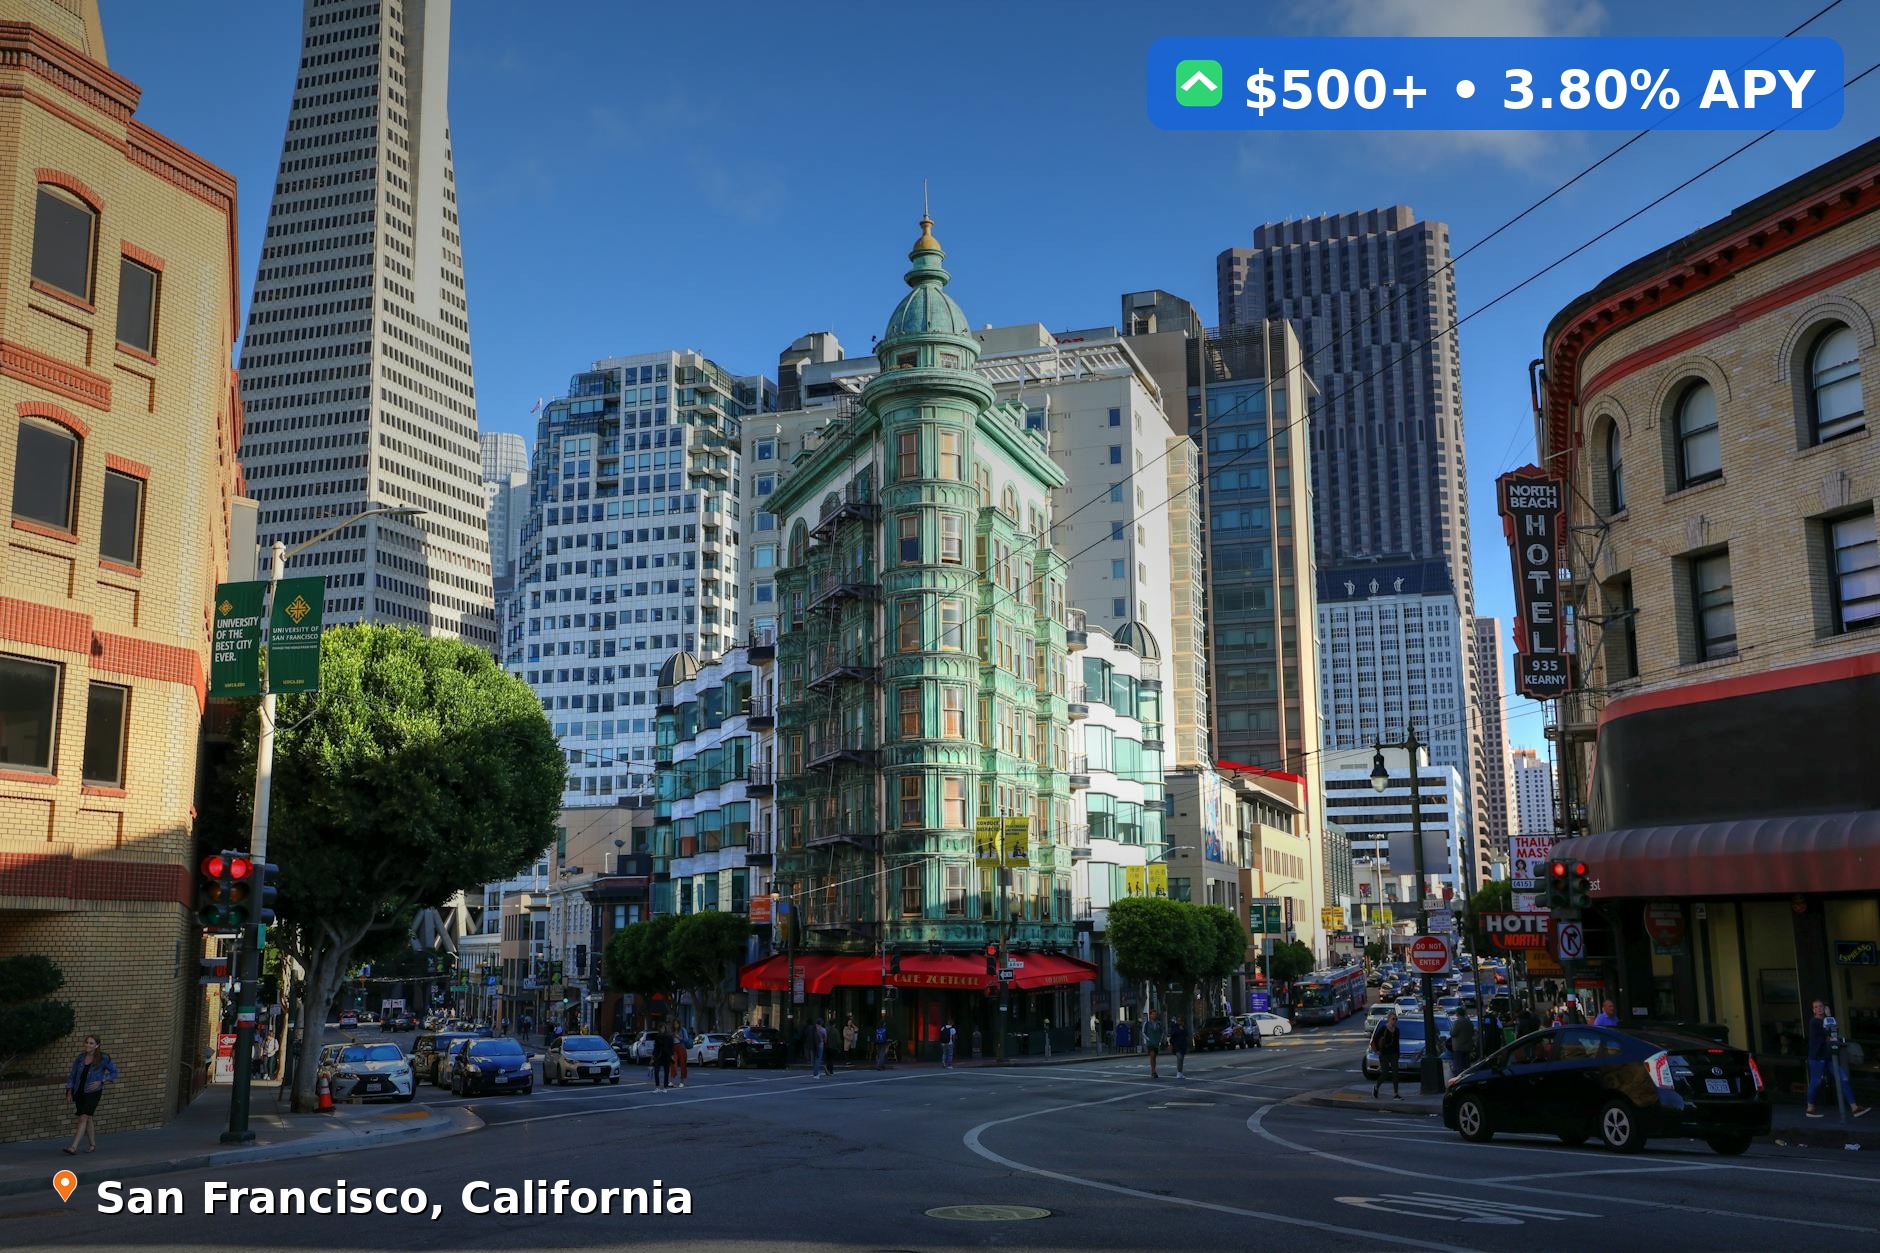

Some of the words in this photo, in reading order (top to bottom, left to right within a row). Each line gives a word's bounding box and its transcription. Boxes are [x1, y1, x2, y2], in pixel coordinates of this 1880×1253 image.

[1510, 485, 1557, 497] NORTH
[1510, 497, 1558, 509] BEACH
[1525, 514, 1556, 654] HOTEL
[217, 616, 259, 629] UNIVERSITY
[216, 630, 227, 640] OF
[228, 629, 244, 639] THE
[273, 626, 309, 634] UNIVERSITY
[215, 641, 235, 651] BEST
[236, 639, 252, 650] CITY
[214, 651, 237, 663] EVER.
[1531, 660, 1558, 672] 935
[1524, 673, 1567, 685] KEARNY
[1516, 848, 1549, 858] MASS
[1513, 880, 1532, 888] (415)
[1486, 915, 1549, 933] HOTE
[1503, 934, 1539, 947] NORTH
